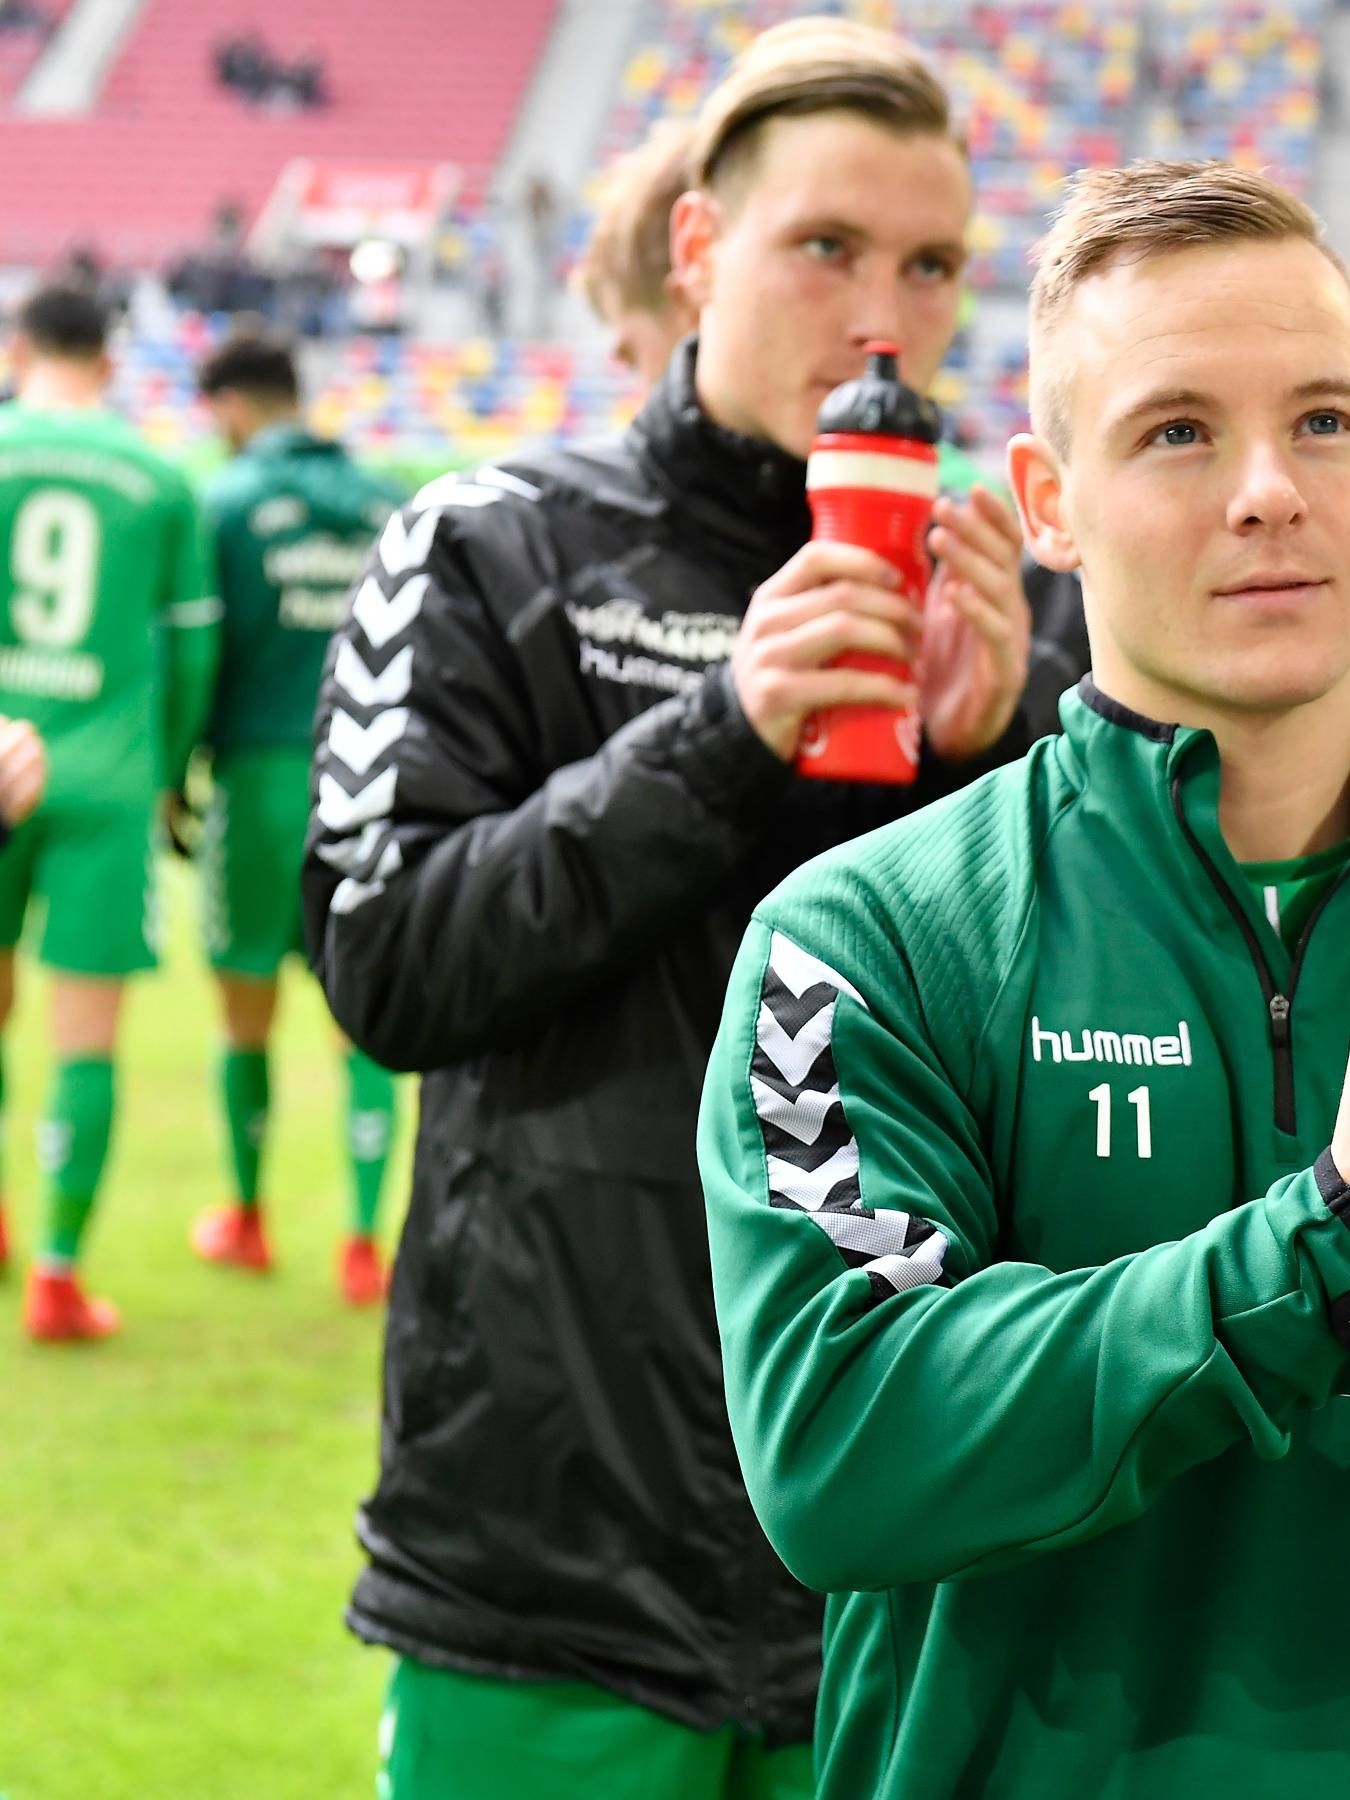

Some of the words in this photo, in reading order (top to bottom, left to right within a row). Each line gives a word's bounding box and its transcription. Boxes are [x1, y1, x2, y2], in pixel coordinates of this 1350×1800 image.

[9, 488, 99, 651] 9
[579, 637, 705, 695] humme
[1032, 1015, 1192, 1067] hummel
[1088, 1082, 1152, 1159] 11
